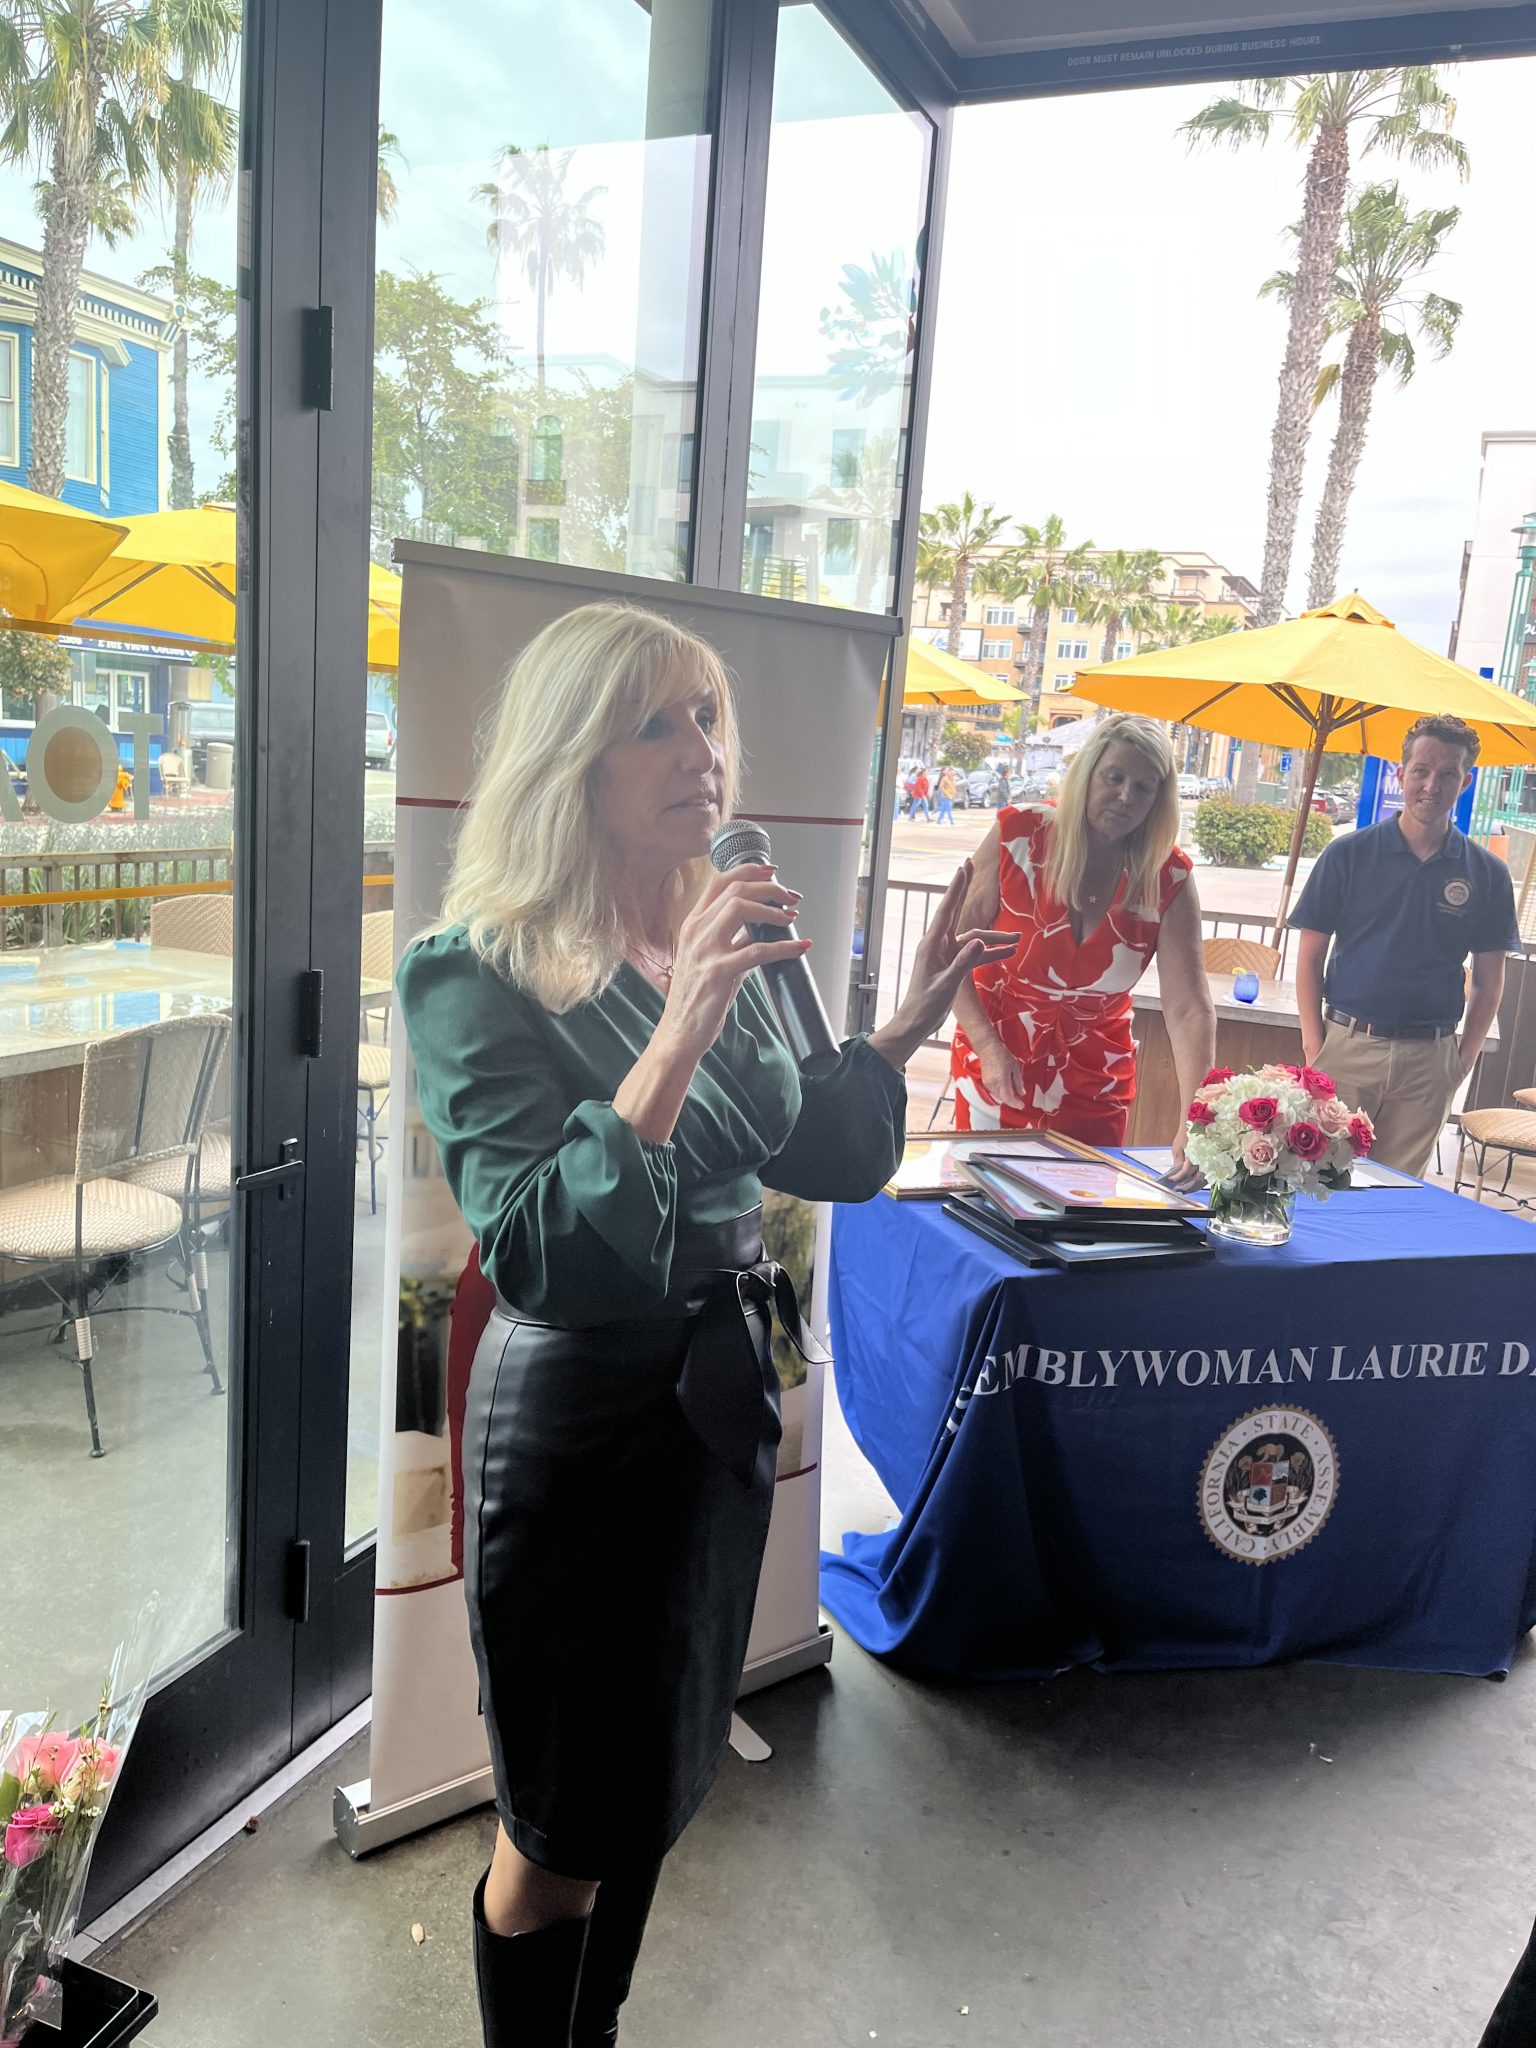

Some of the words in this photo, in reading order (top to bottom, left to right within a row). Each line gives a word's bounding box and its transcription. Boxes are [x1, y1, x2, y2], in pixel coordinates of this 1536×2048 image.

[1067, 56, 1091, 66] DOOR
[1093, 53, 1118, 64] MUST
[1120, 49, 1154, 61] REMAIN
[1156, 46, 1202, 58] UNLOCKED
[1205, 42, 1239, 54] DURING
[1241, 38, 1287, 51] BUSINESS
[1289, 35, 1321, 47] HOURS
[1327, 1342, 1489, 1381] LAURIE
[1497, 1341, 1536, 1377] D
[1253, 1415, 1314, 1439] STATE
[1207, 1440, 1256, 1553] CALIFORNIA
[1271, 1453, 1331, 1550] ASSEMBLY
